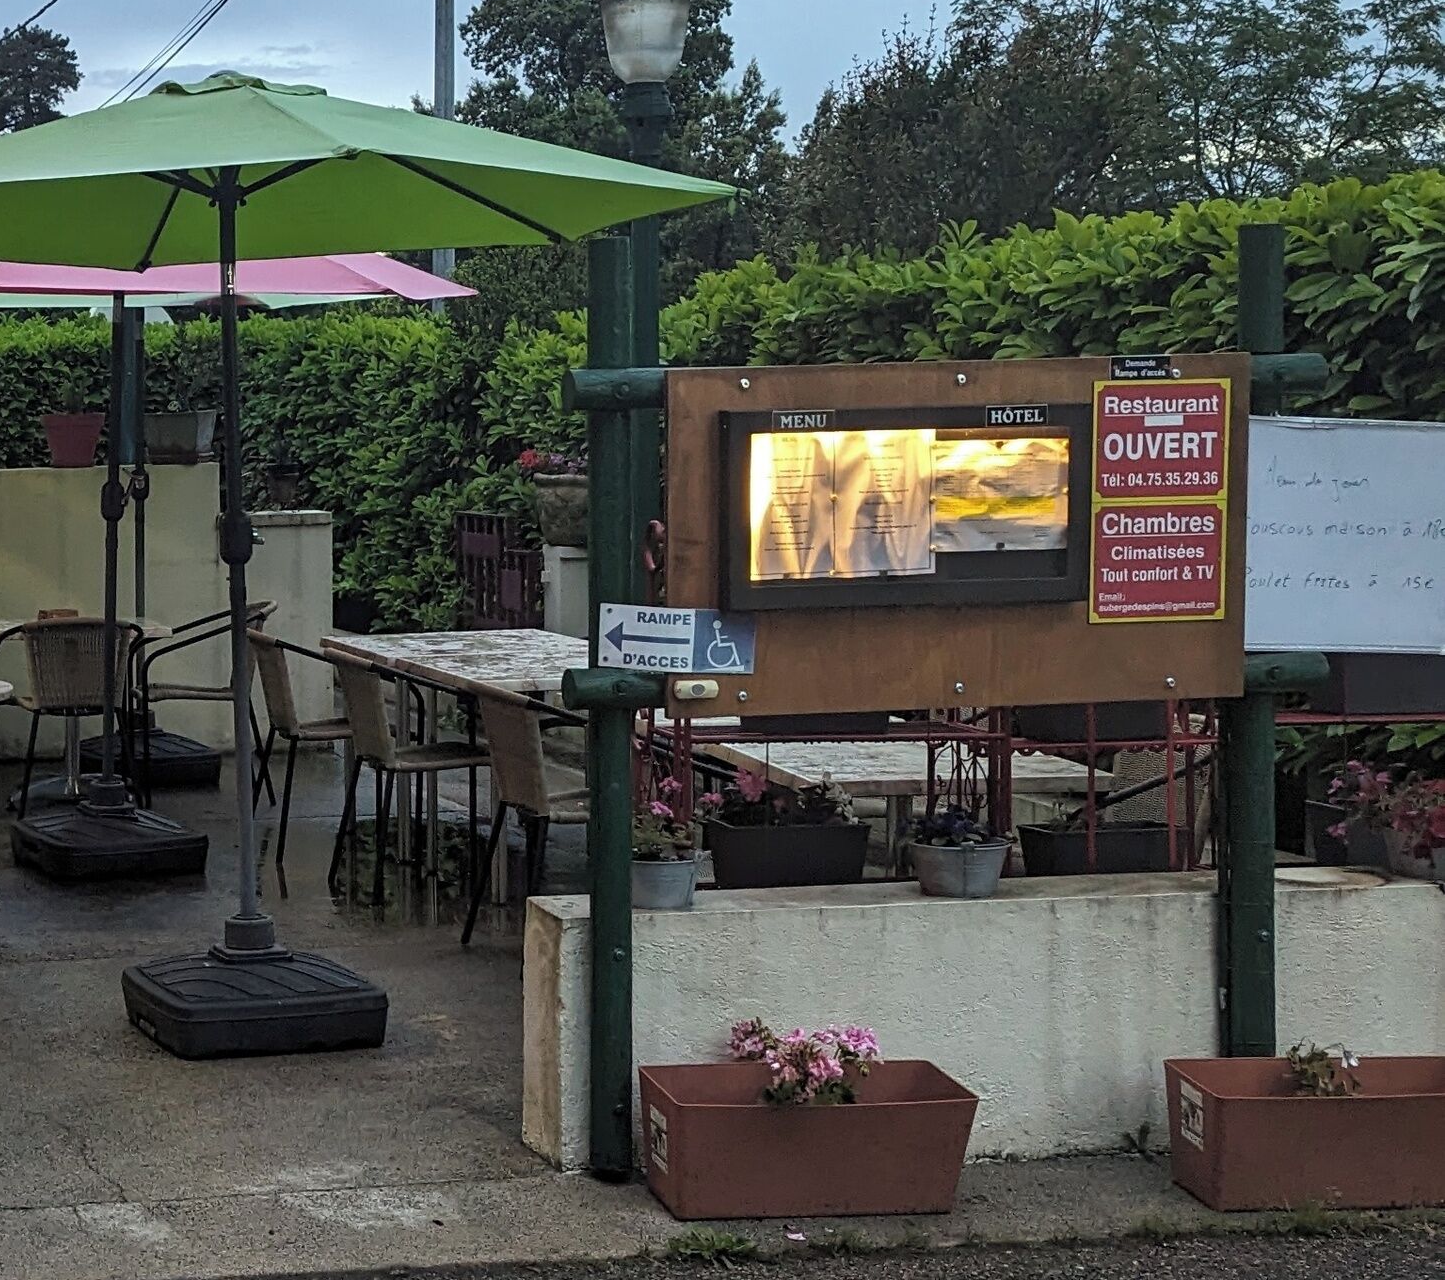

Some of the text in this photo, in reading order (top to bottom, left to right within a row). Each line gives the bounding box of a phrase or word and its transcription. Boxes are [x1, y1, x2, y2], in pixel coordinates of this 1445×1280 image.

[1125, 359, 1156, 368] Demande
[1114, 368, 1139, 378] Rampe
[1104, 395, 1219, 414] Restaurant
[780, 414, 827, 429] MENU
[990, 407, 1044, 424] HÔTEL
[1104, 431, 1218, 461] OUVERT
[1101, 471, 1219, 487] Tél: 04.75.35.29.36
[1102, 512, 1215, 535] Chambres
[1246, 517, 1314, 536] ouscous
[1111, 544, 1205, 561] Climatisées
[1101, 565, 1215, 583] Tout confort & TV
[1098, 601, 1216, 613] aubergedespins@gmail.com
[637, 611, 692, 626] RAMPE
[623, 653, 689, 669] D'ACCES
